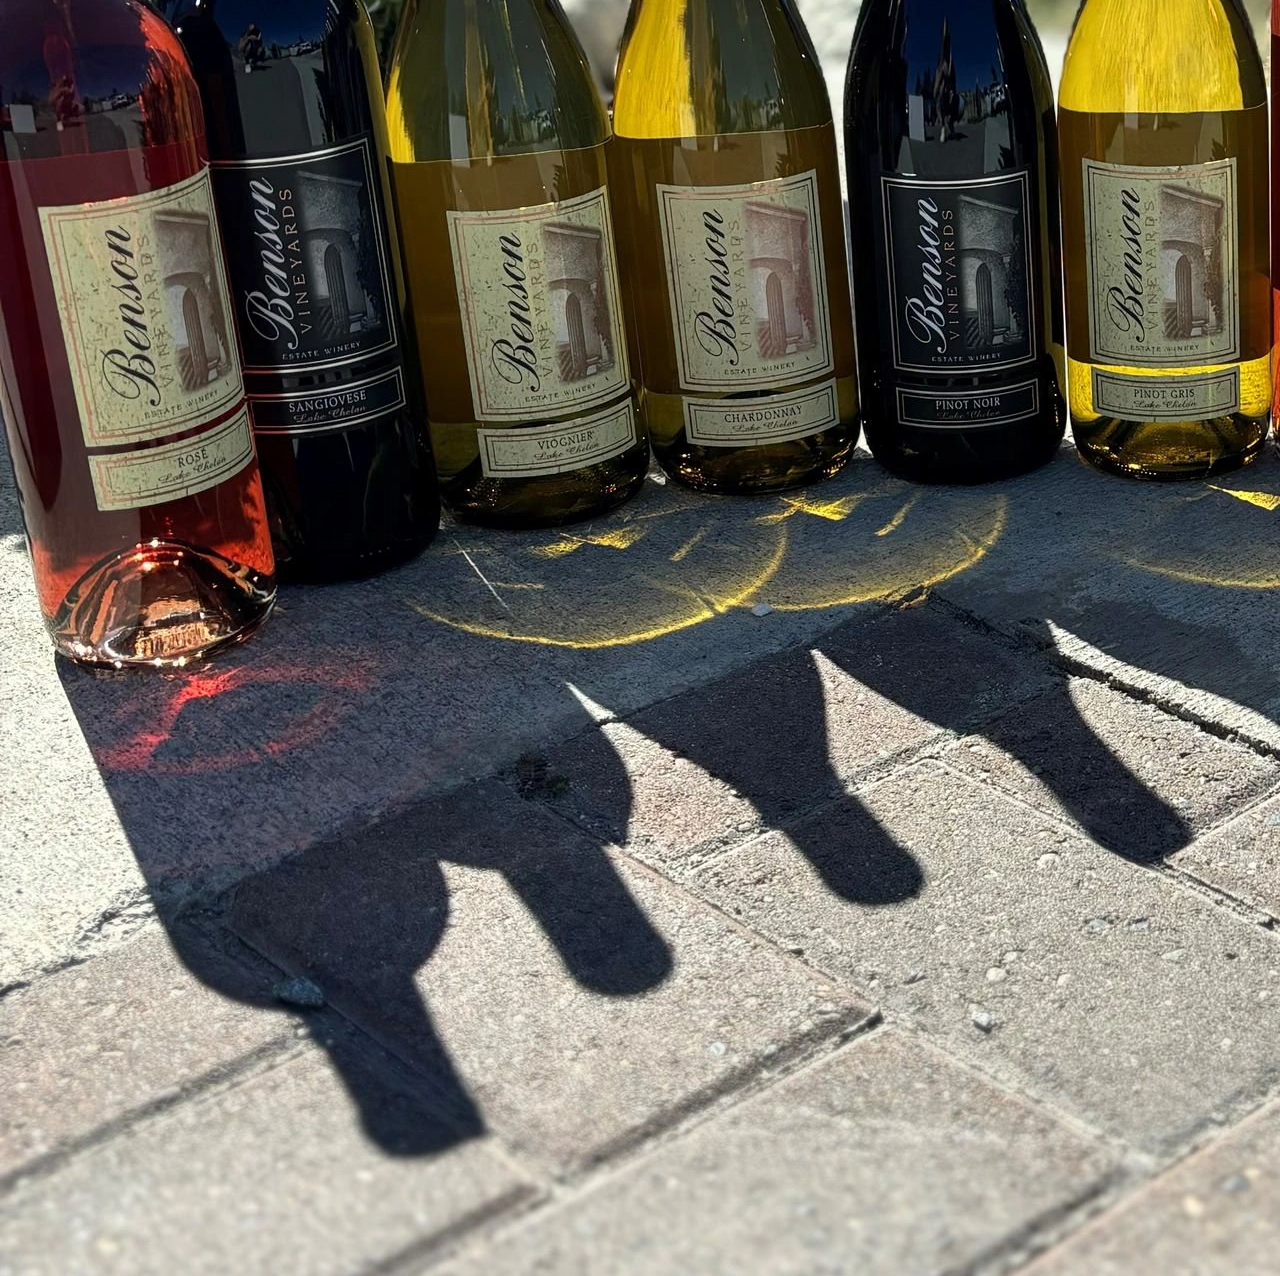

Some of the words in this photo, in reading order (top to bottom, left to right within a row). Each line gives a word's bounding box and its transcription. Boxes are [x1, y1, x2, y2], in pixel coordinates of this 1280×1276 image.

[245, 176, 299, 350] Benson
[279, 188, 312, 334] VINEYARDS
[1106, 187, 1146, 342] Benson
[905, 197, 947, 354] Benson
[942, 210, 960, 340] VINEYARDS
[693, 208, 740, 366] Benson
[100, 225, 162, 407] Benson
[492, 232, 541, 393] Benson
[526, 242, 554, 377] VINEYARDS
[282, 350, 320, 361] ESTATE
[324, 341, 362, 355] WINERY
[1165, 344, 1200, 352] WINERY
[724, 367, 757, 375] ESTATE
[762, 362, 795, 372] WINERY
[931, 355, 964, 363] ESTATE
[187, 390, 219, 408] WINERY
[289, 390, 367, 413] SANGIOVESE
[525, 393, 559, 403] ESTATE
[563, 383, 597, 396] WINERY
[935, 399, 969, 410] PINOT
[973, 397, 1000, 408] NOIR
[1134, 389, 1166, 399] PINOT
[1170, 388, 1195, 398] GRIS
[724, 405, 804, 424] CHARDONNAY
[538, 431, 595, 450] VIOGNIER
[177, 447, 209, 468] ROSÉ
